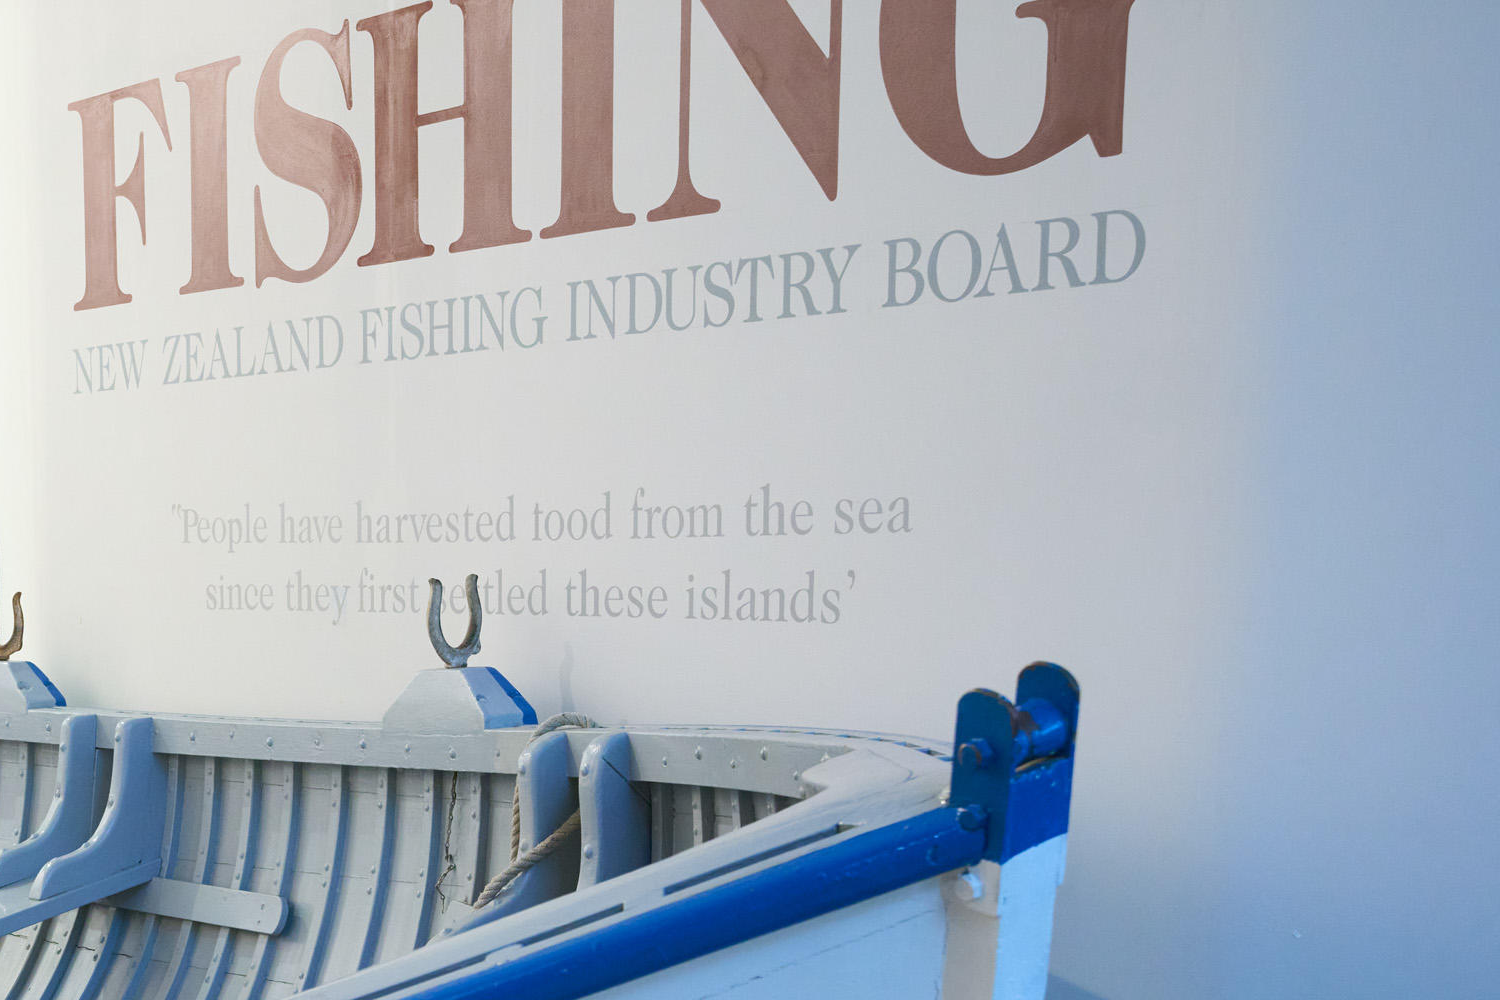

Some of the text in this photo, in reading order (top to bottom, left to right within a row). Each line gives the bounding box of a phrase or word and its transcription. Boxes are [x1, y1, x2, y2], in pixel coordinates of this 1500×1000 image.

[67, 0, 1138, 312] FISHING
[72, 209, 1147, 395] NEW ZEALAND FISHING INDUSTRY BOARD
[278, 500, 343, 544] have
[354, 495, 517, 545] harvested
[629, 486, 725, 540] from
[743, 482, 814, 537] the
[833, 496, 914, 535] sea
[205, 566, 857, 627] since they first etled these islands'
